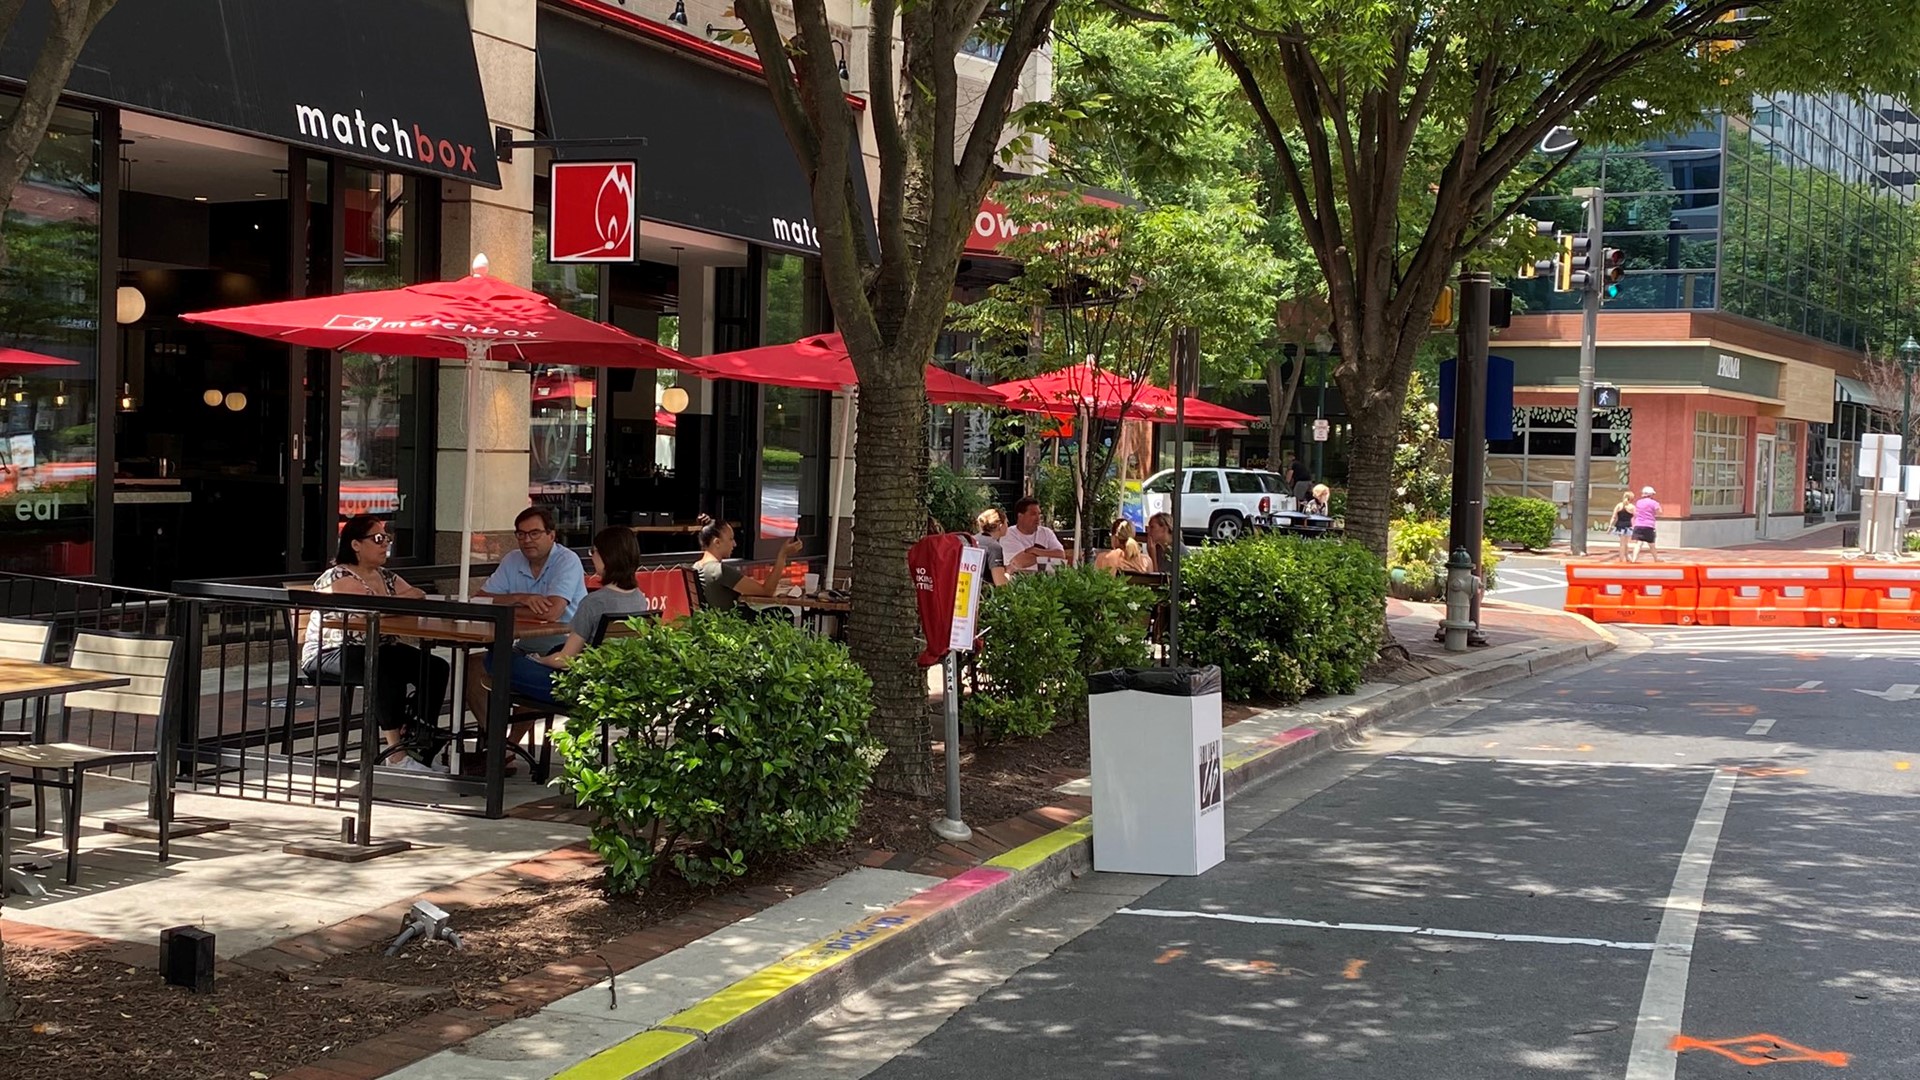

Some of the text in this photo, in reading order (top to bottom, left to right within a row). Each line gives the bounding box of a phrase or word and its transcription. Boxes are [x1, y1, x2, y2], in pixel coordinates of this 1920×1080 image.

[295, 104, 477, 173] matchbox
[381, 319, 541, 338] matchbox
[15, 492, 60, 521] eat
